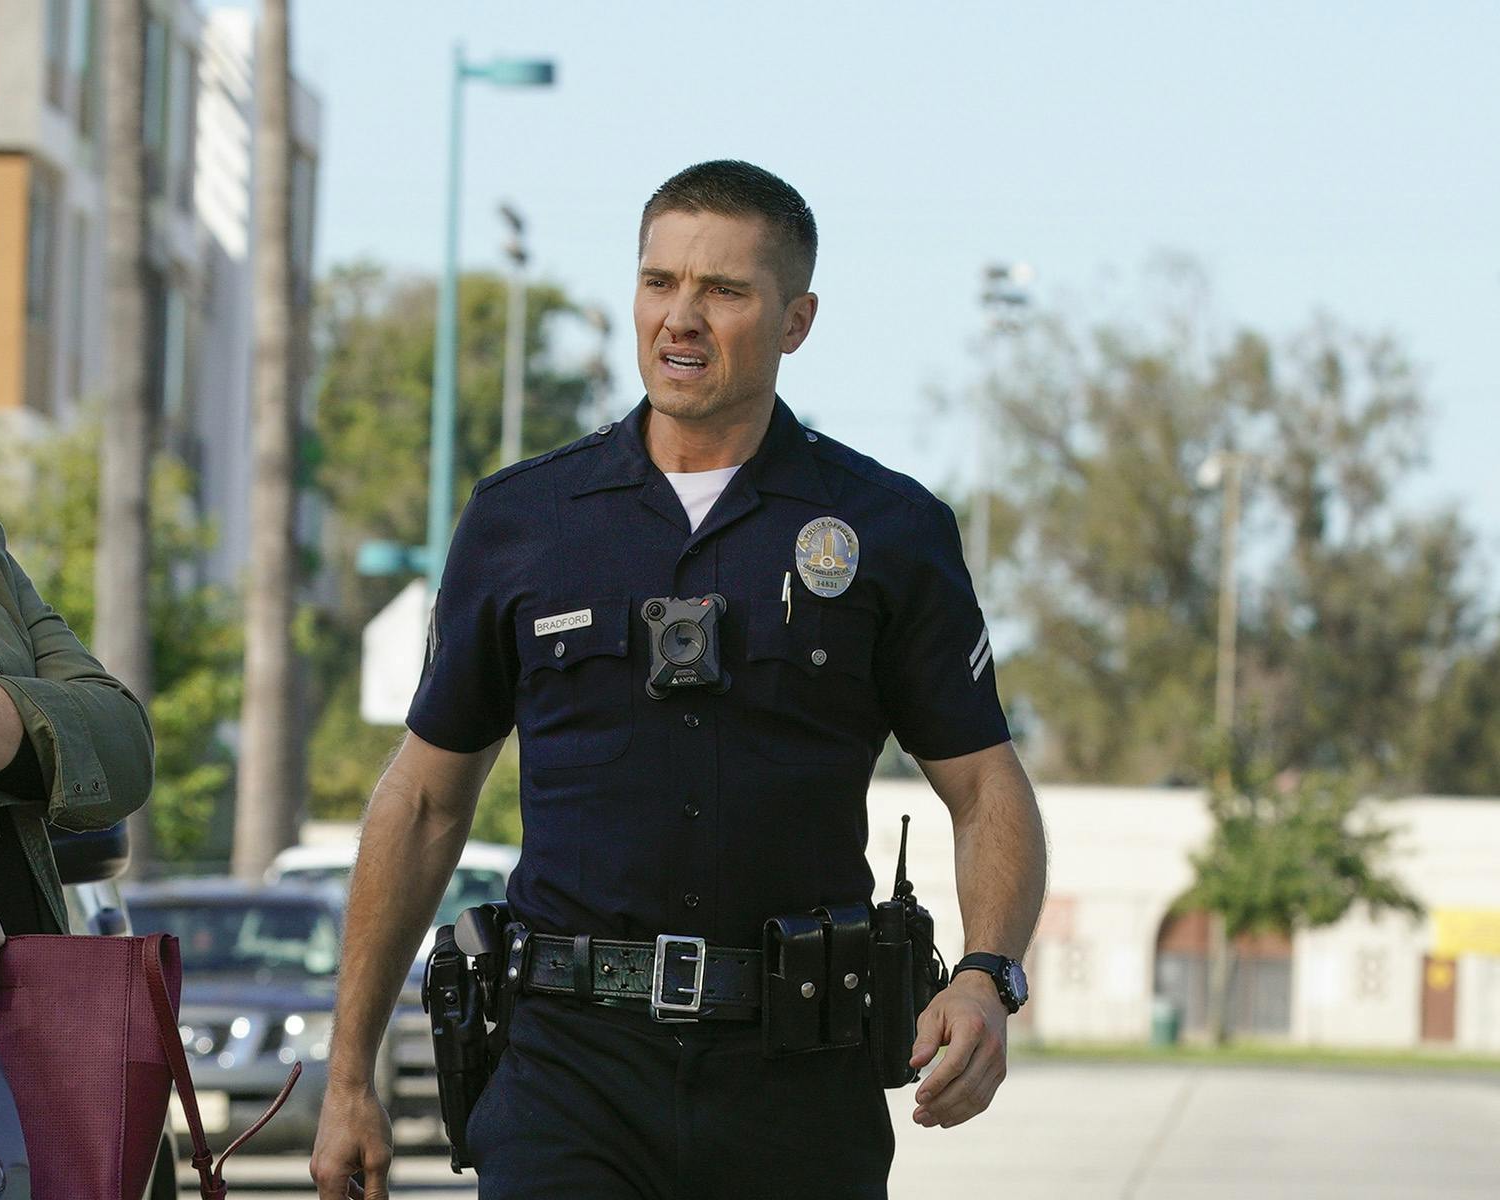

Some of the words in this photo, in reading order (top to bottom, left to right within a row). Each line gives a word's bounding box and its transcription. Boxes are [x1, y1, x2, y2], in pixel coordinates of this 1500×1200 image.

[804, 521, 826, 539] POLICE
[827, 521, 853, 543] OFFICER
[812, 568, 834, 576] ANGELES
[537, 614, 589, 632] BRADFORD
